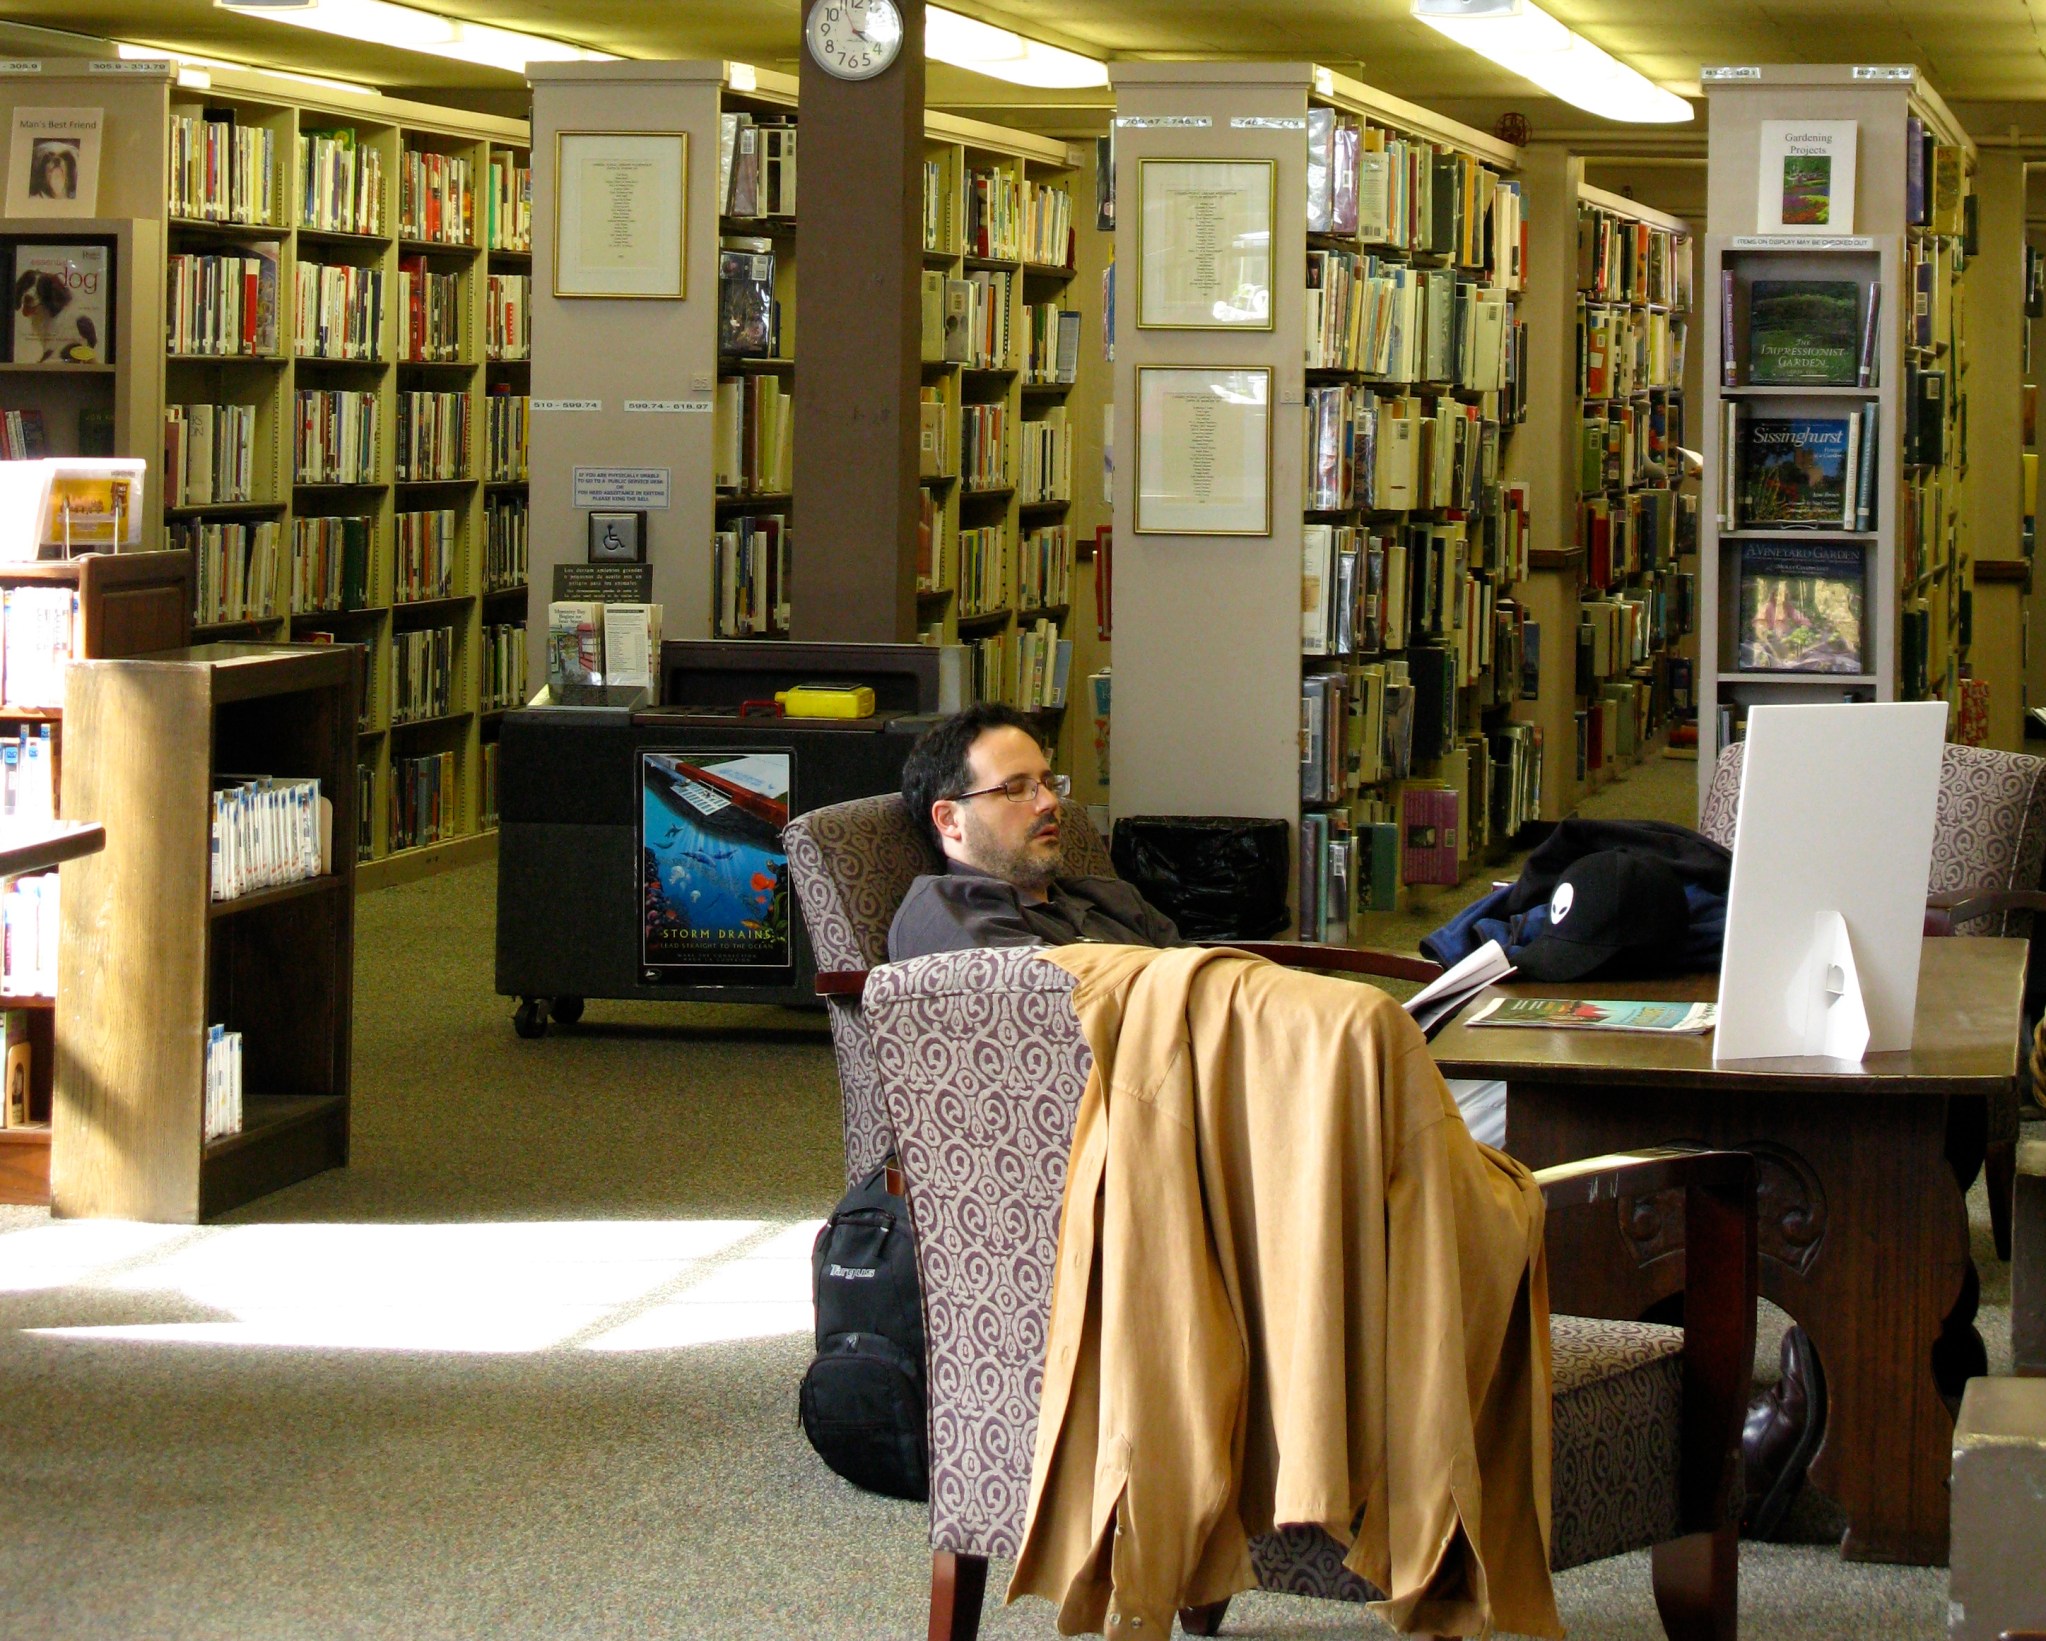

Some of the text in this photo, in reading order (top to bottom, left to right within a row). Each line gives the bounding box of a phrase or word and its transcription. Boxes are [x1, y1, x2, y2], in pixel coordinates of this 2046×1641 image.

[825, 8, 840, 22] 10
[820, 23, 830, 36] 9
[825, 40, 834, 53] 8
[872, 42, 882, 56] 4
[838, 52, 846, 66] 7
[848, 55, 858, 68] 6
[862, 52, 870, 66] 5
[20, 120, 97, 130] Man's Best Friend
[1784, 133, 1832, 144] Gardening
[1790, 145, 1826, 156] Projects
[1760, 344, 1845, 356] IMPRESSIONIST
[1778, 356, 1826, 368] GARDEN
[1753, 427, 1844, 447] Sissinghurst
[1746, 544, 1756, 556] A
[1756, 544, 1812, 558] VINEYARD
[1813, 546, 1860, 560] GARDEN
[663, 928, 771, 939] STORM DRAINS
[830, 1263, 876, 1280] Targus
